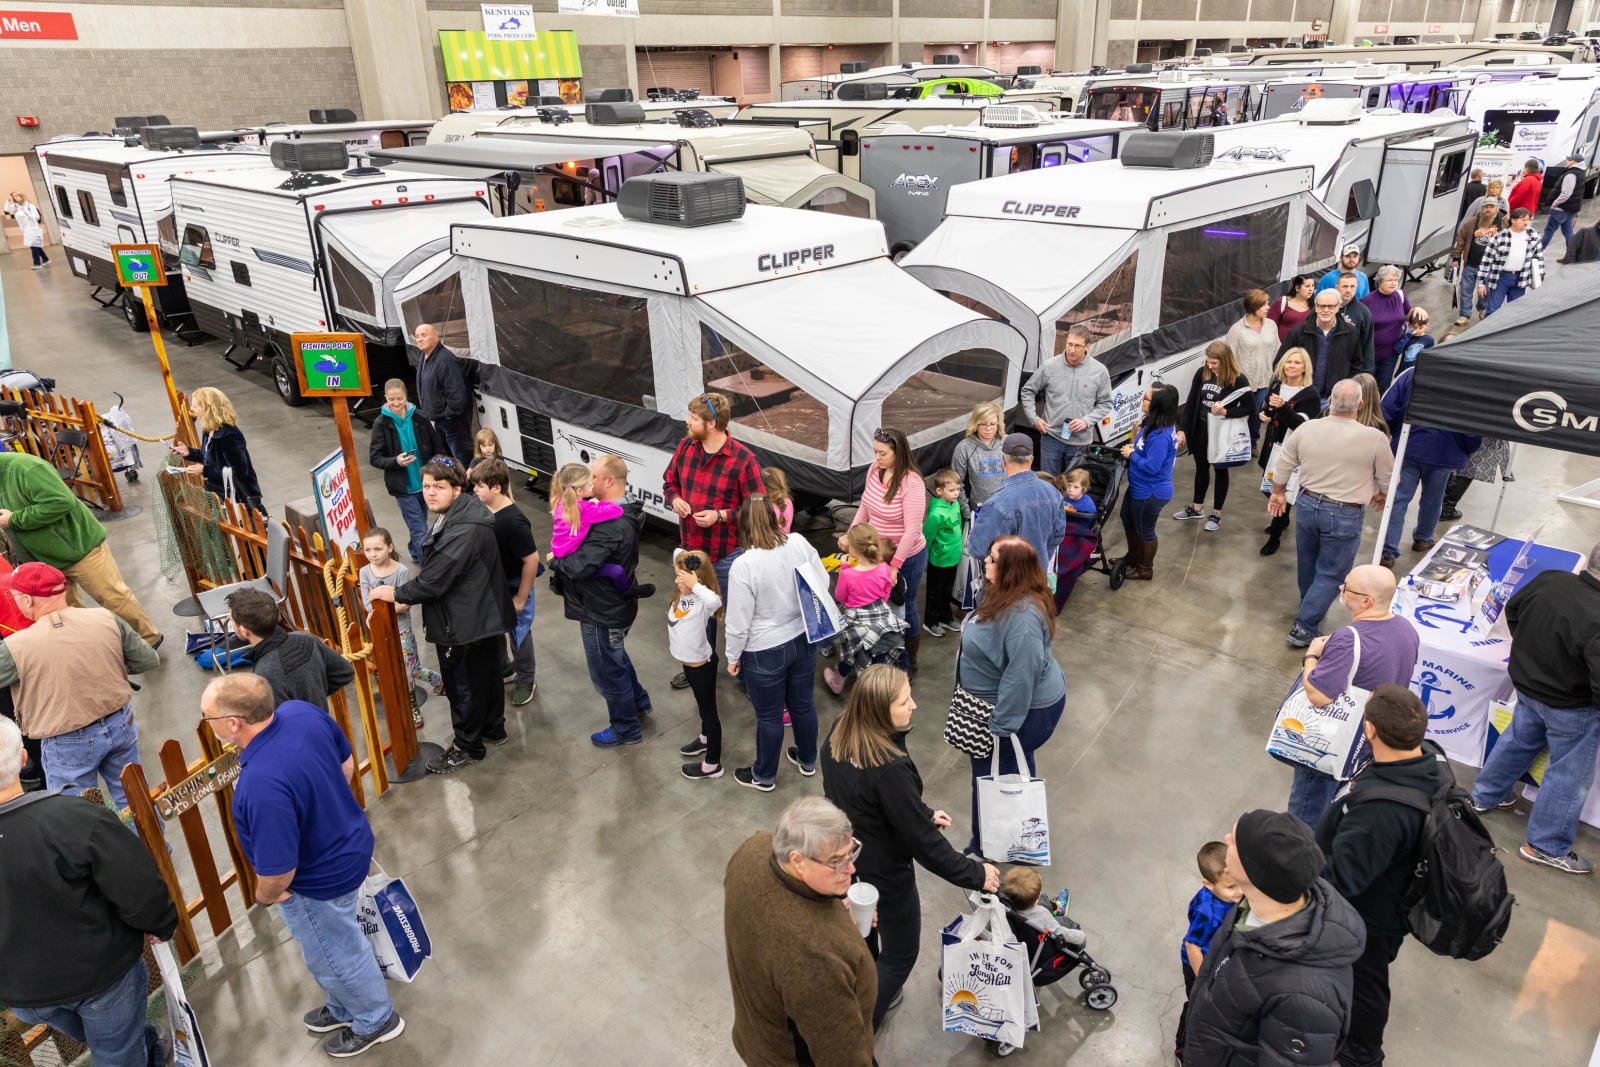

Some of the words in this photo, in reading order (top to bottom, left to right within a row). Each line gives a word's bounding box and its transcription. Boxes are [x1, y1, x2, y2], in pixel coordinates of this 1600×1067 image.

[484, 8, 532, 16] KENTUCKY
[2, 17, 42, 33] Men
[1213, 145, 1292, 162] APEX
[889, 172, 939, 190] APEX
[1002, 200, 1081, 219] CLIPPER
[214, 232, 241, 247] CLIPPER
[758, 244, 834, 272] CLIPPER
[133, 272, 148, 280] OUT
[302, 342, 331, 350] FISHING
[327, 376, 340, 386] IN
[327, 488, 352, 527] Trout
[336, 508, 355, 539] Pon
[1422, 660, 1475, 691] MARINE
[1340, 692, 1356, 708] FOR
[1434, 722, 1471, 735] SERVICE
[192, 781, 216, 803] GONE
[361, 906, 377, 917] FOR
[392, 905, 421, 954] PROGRESSIVE
[969, 952, 980, 961] IN
[982, 952, 990, 961] IT
[994, 956, 1013, 970] FOR
